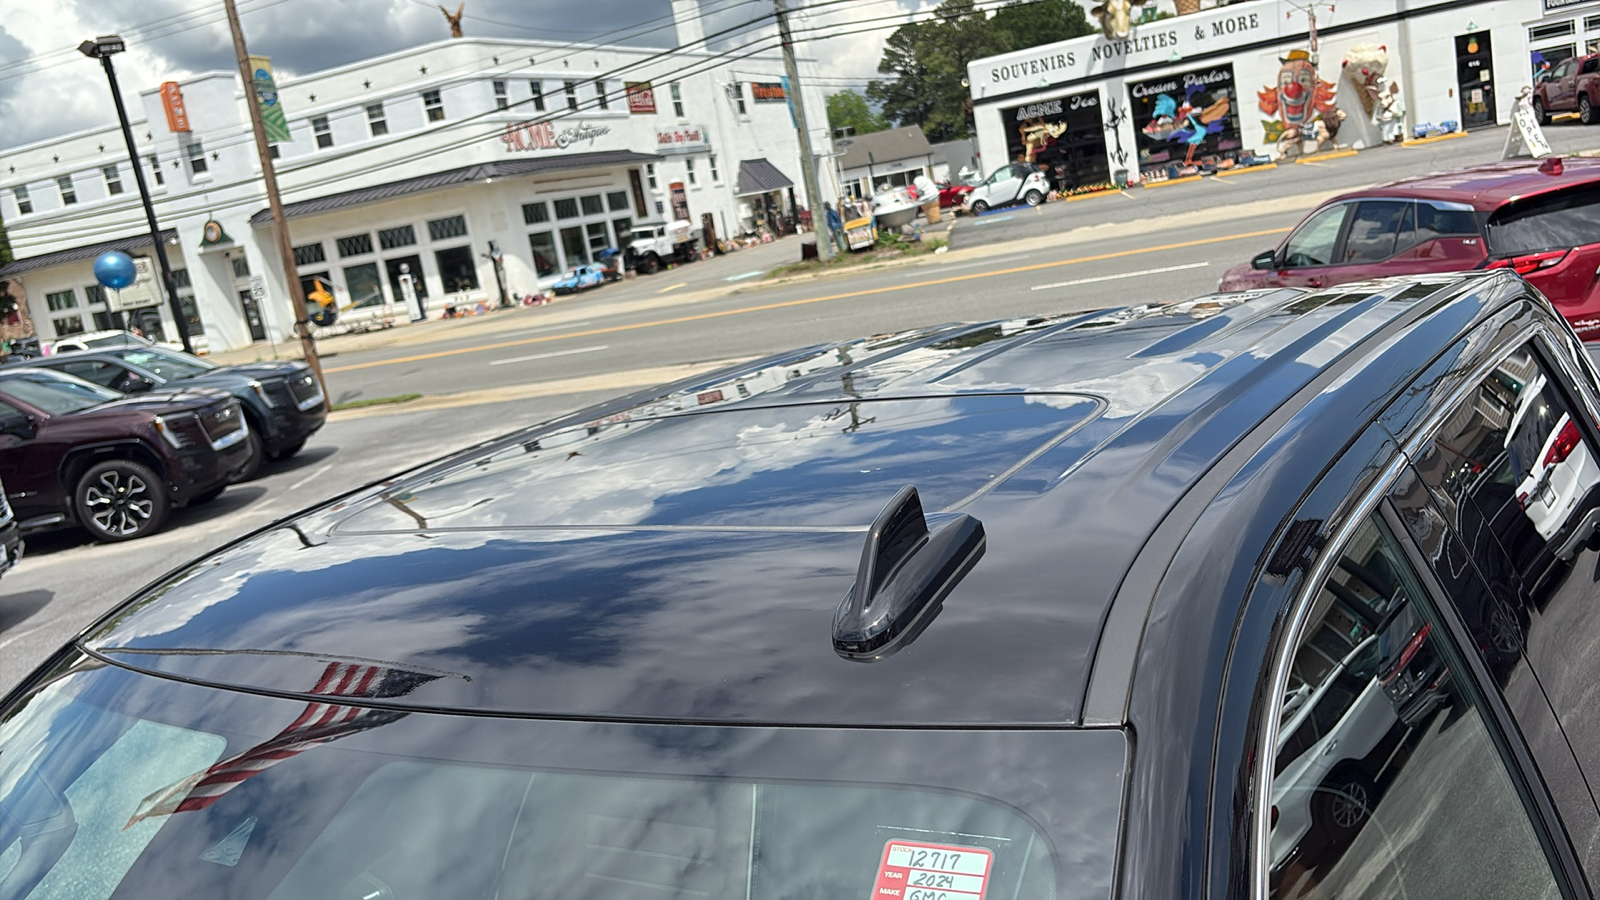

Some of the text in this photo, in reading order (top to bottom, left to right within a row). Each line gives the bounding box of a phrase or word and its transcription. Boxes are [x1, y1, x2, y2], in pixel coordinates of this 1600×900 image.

[991, 13, 1260, 83] SOUVENIRS NOVELTIES & MORE
[1131, 70, 1232, 98] Cream Parlor
[1016, 94, 1098, 121] ACME Ice
[500, 120, 557, 152] ACME
[908, 850, 961, 870] 12717
[884, 871, 903, 879] YEAR
[912, 872, 954, 888] 2024
[879, 887, 901, 897] MAKE
